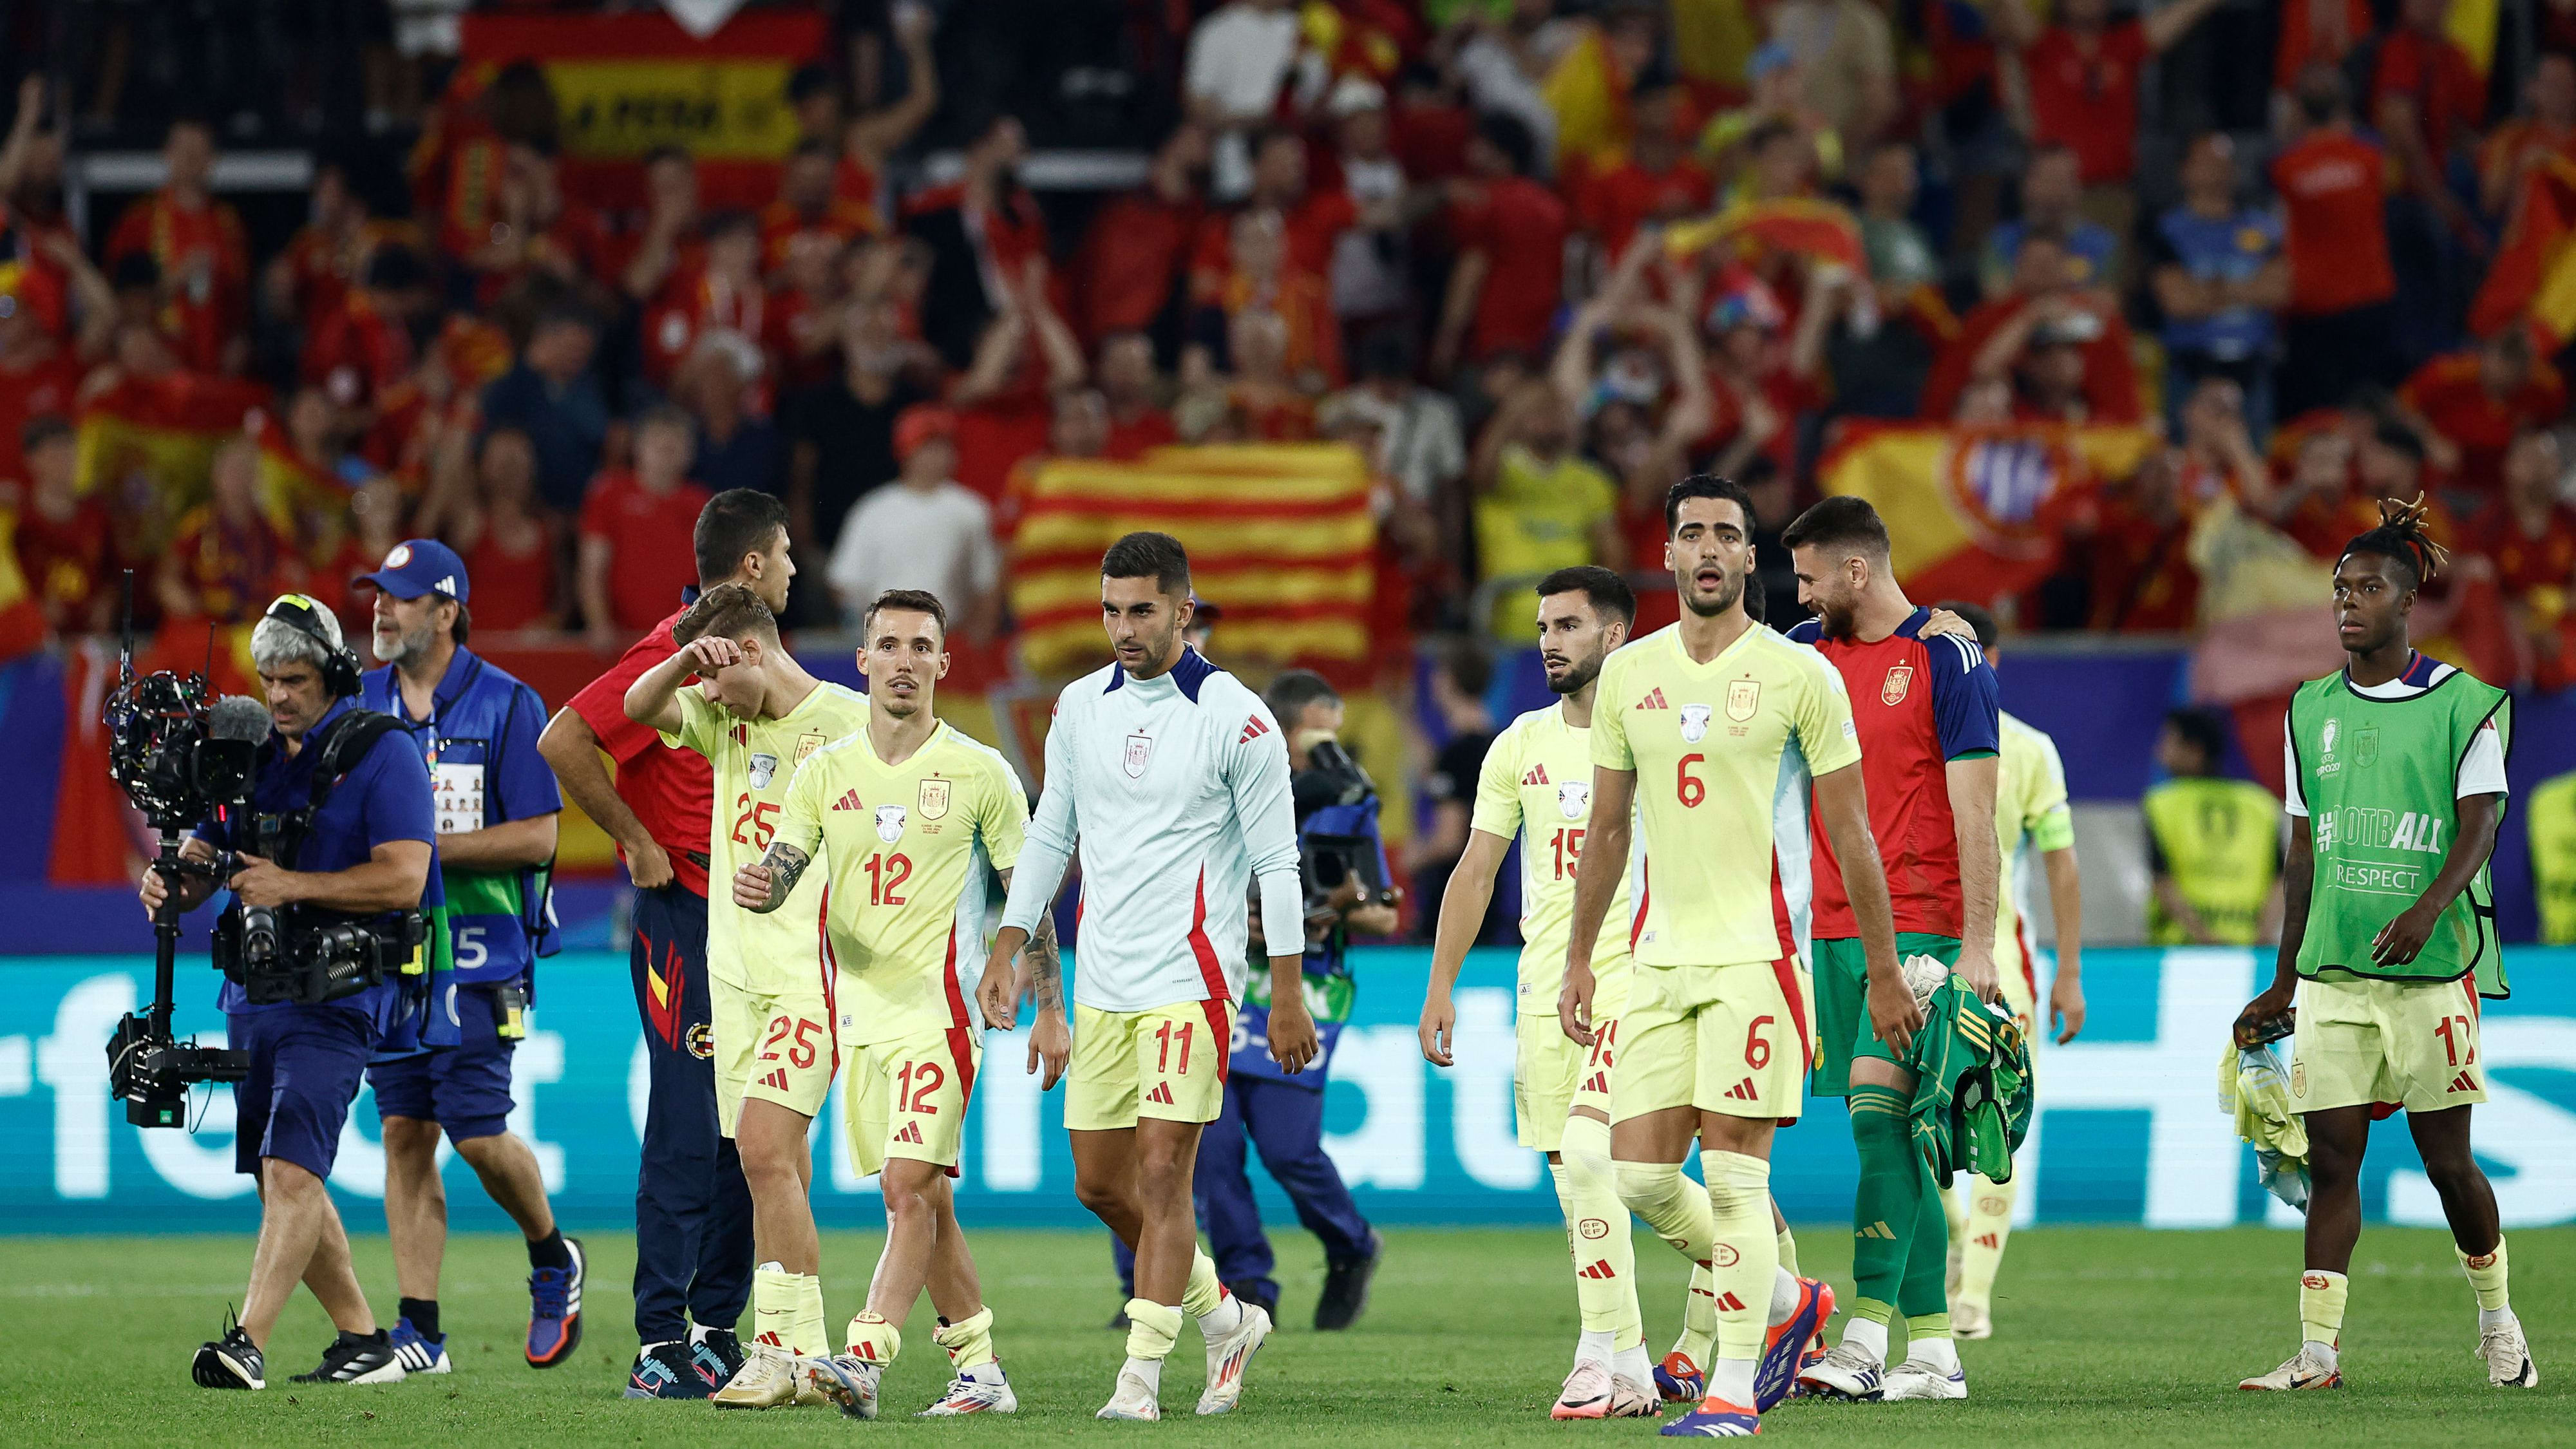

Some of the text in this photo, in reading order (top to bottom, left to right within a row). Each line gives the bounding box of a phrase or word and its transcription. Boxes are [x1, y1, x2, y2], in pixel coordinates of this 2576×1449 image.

[1677, 753, 1705, 808] 6
[732, 792, 781, 853] 25
[864, 853, 913, 905] 12
[2336, 864, 2420, 890] RESPECT
[758, 1015, 823, 1069] 25
[1155, 1020, 1193, 1075] 11
[1745, 1015, 1775, 1070] 6
[2434, 1015, 2475, 1067] 17
[898, 1061, 944, 1115] 12
